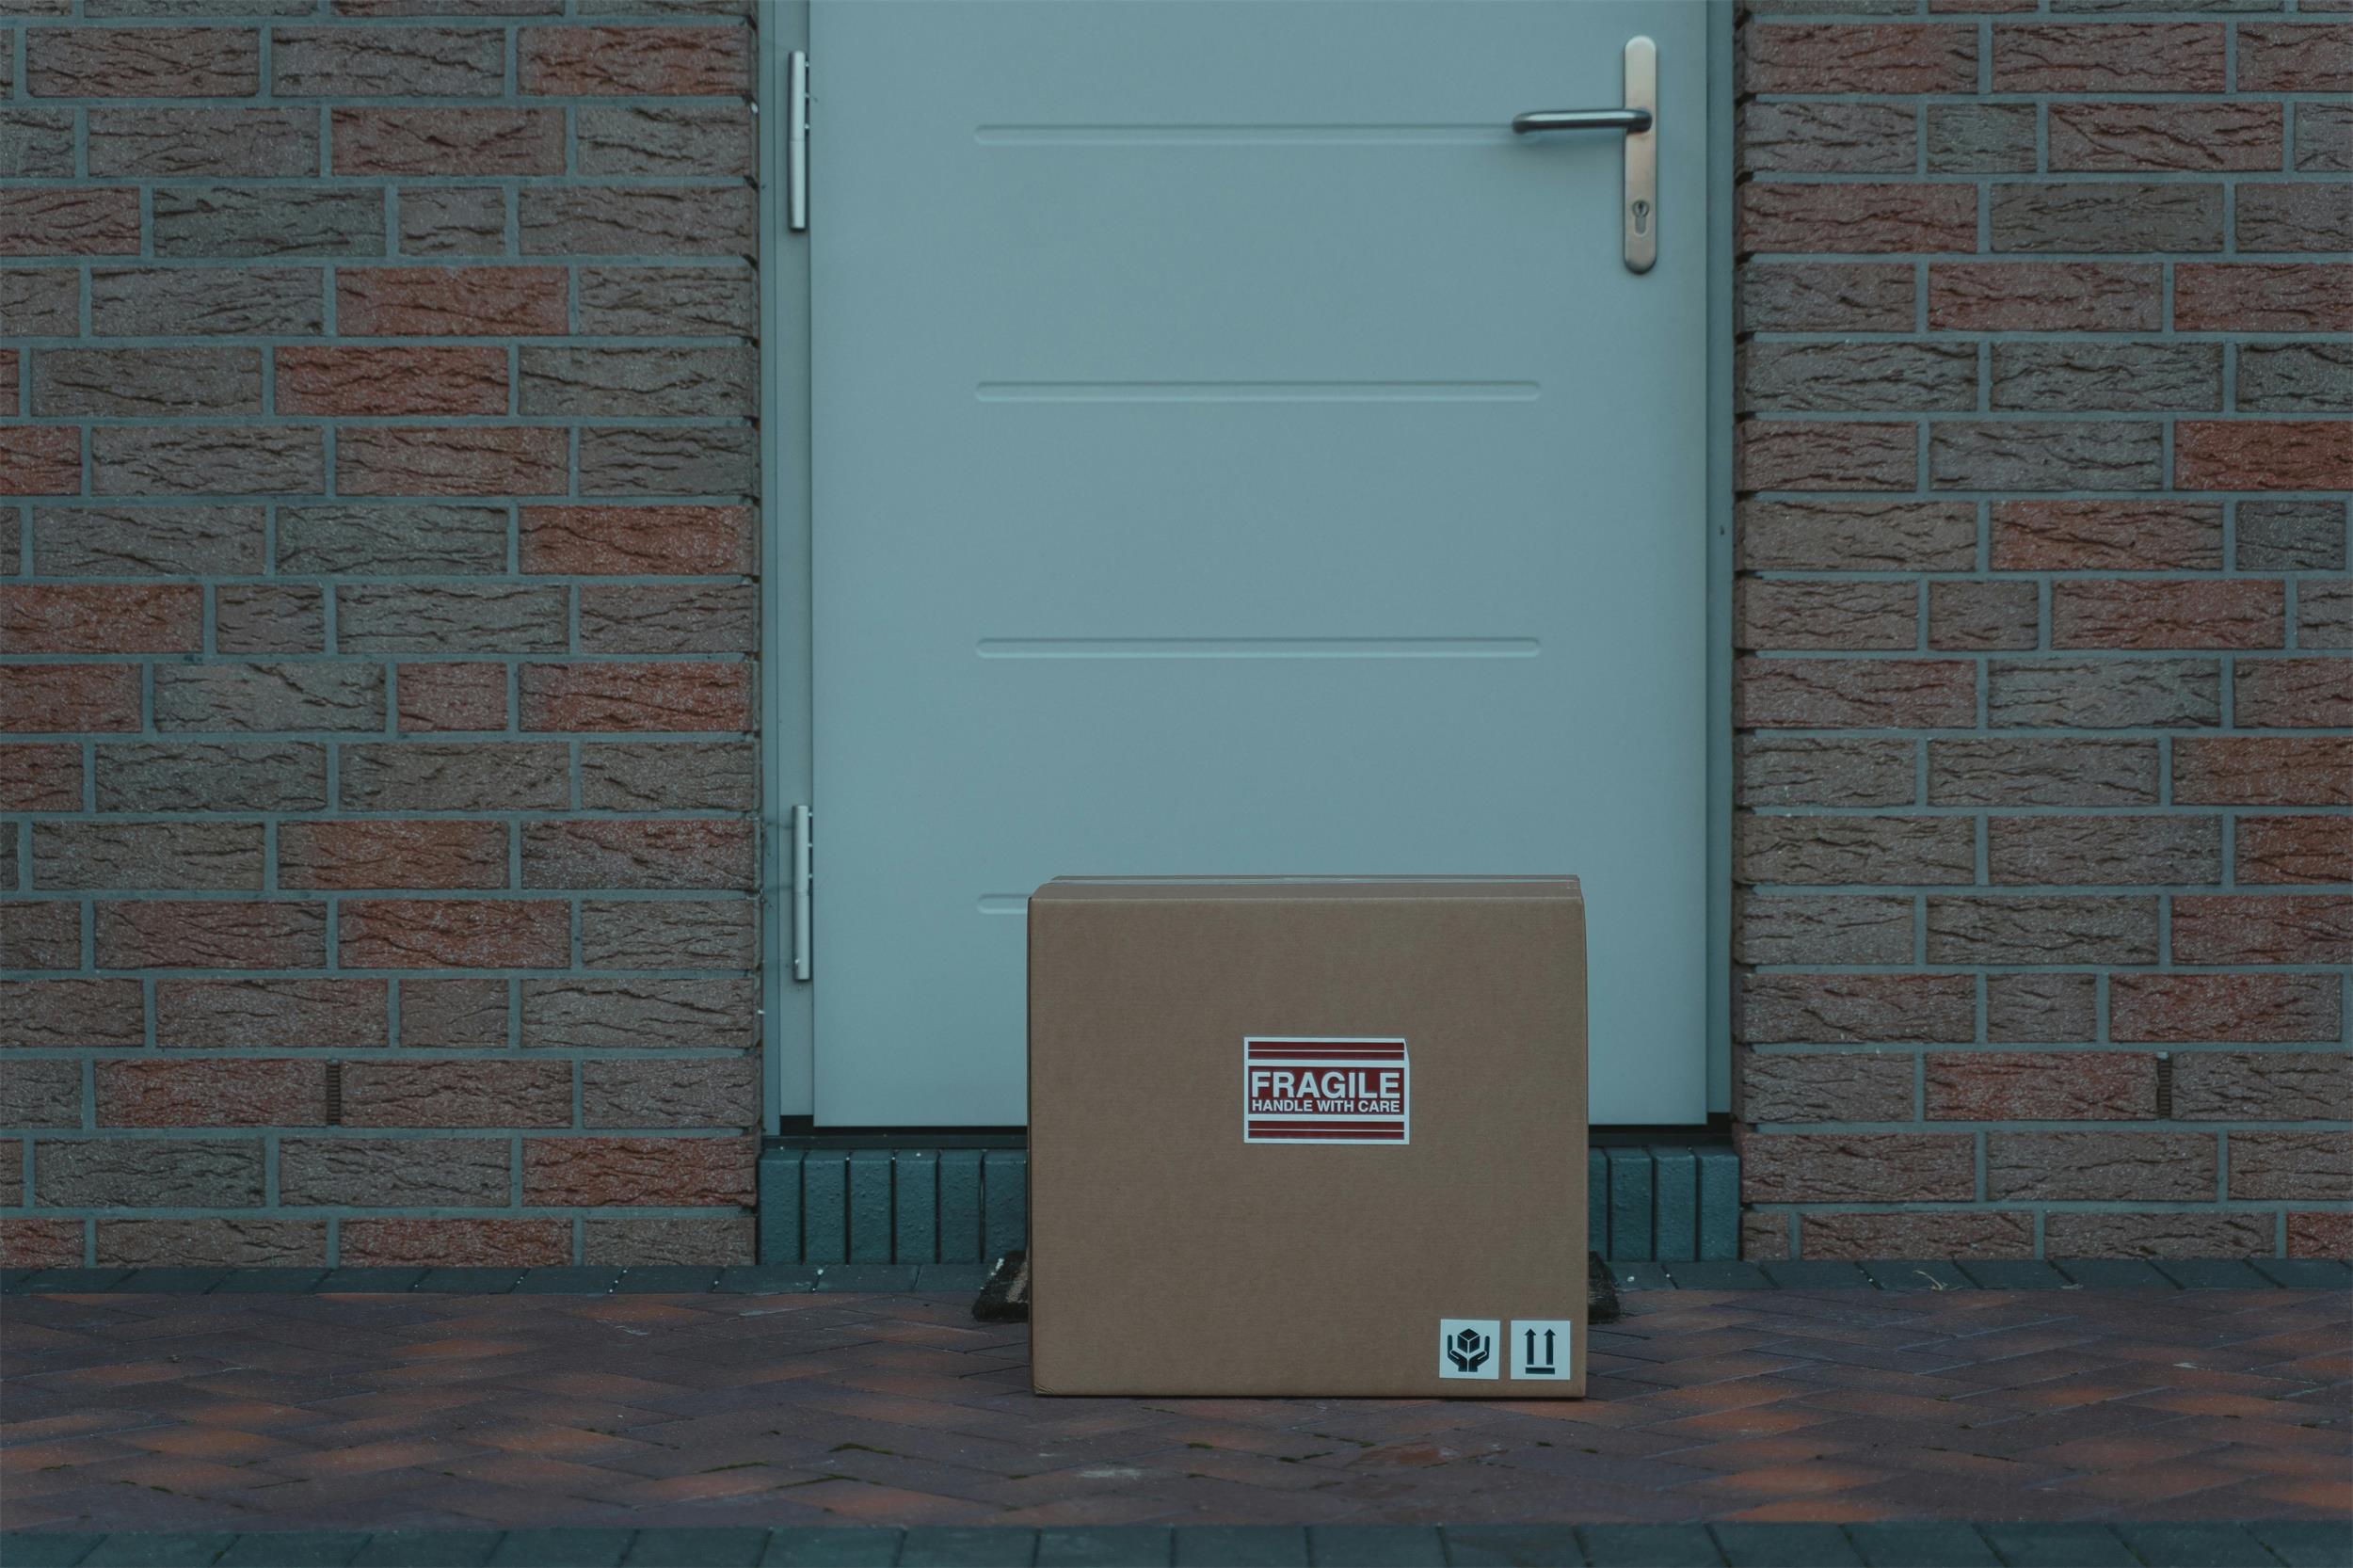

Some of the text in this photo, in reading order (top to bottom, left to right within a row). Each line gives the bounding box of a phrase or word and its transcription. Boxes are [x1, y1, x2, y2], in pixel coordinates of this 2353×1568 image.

[1252, 1071, 1401, 1099] FRAGILE
[1252, 1099, 1401, 1112] HANDLE WITH CARE
